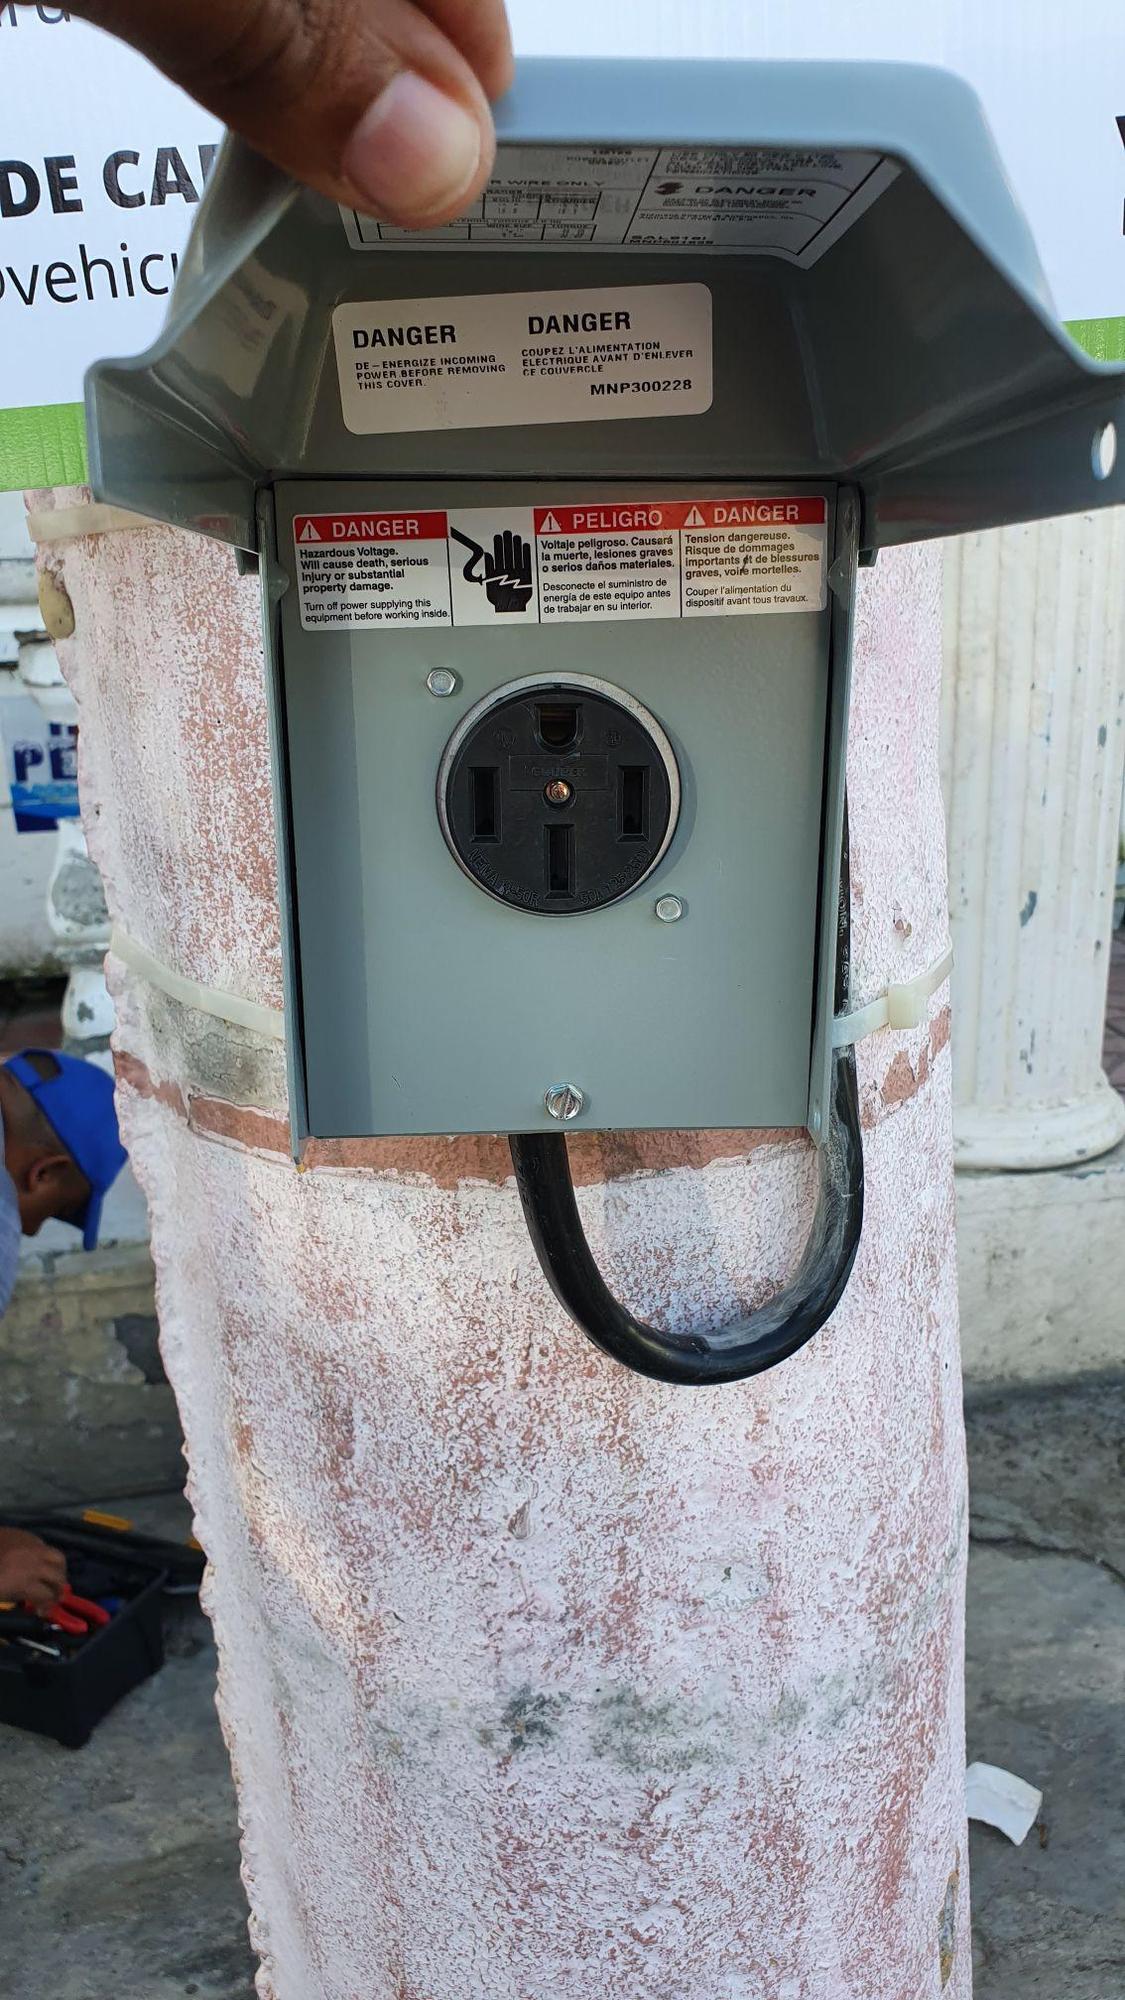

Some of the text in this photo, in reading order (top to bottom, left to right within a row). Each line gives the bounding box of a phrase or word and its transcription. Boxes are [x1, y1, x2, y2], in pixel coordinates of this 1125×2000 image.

[0, 155, 83, 217] DE
[695, 186, 817, 198] DANGER
[0, 243, 177, 306] vehic
[528, 311, 631, 335] DANGER
[353, 324, 457, 348] DANGER
[522, 341, 660, 357] COUPEZ L'ALIMENTATION
[441, 355, 496, 365] INCOMING
[522, 350, 693, 366] ELECTRIQUE AVANT D'ENLEVER
[356, 364, 506, 380] POWER BEFORE REMOVING
[523, 364, 604, 376] CE COUVERCLE
[359, 379, 426, 390] THIS COVER.
[590, 379, 692, 395] MNP300228
[572, 510, 663, 529] PELIGRO
[714, 504, 799, 524] DANGER
[332, 519, 420, 538] DANGER
[540, 535, 673, 551] Voltaje peligroso. Causará
[685, 532, 790, 544] Tension dangereuse.
[300, 547, 399, 558] Hazardous Voltage.
[541, 548, 673, 561] la muerte, lesiones graves
[685, 543, 795, 556] Risque de dommages
[301, 556, 430, 569] Will cause death, serious
[552, 562, 583, 572] serios
[586, 561, 617, 570] daños
[620, 559, 674, 569] materiales.
[685, 556, 740, 568] importants
[755, 555, 768, 563] de
[771, 553, 819, 563] blessures
[348, 569, 404, 579] substantial
[685, 565, 801, 580] graves, voire mortelles.
[303, 582, 394, 594] property damage.
[543, 578, 667, 591] Desconecte el suministro de
[685, 583, 792, 597] Couper l'alimentation du
[544, 594, 576, 603] energía
[579, 592, 591, 600] de
[615, 590, 644, 600] equipo
[647, 590, 671, 598] antes
[685, 595, 808, 608] dispositif avant tous travaux.
[304, 599, 431, 611] Turn off power supplying this
[544, 605, 555, 613] de
[558, 604, 591, 614] trabajar
[620, 600, 652, 610] interior.
[305, 609, 450, 623] equipment before working inside.
